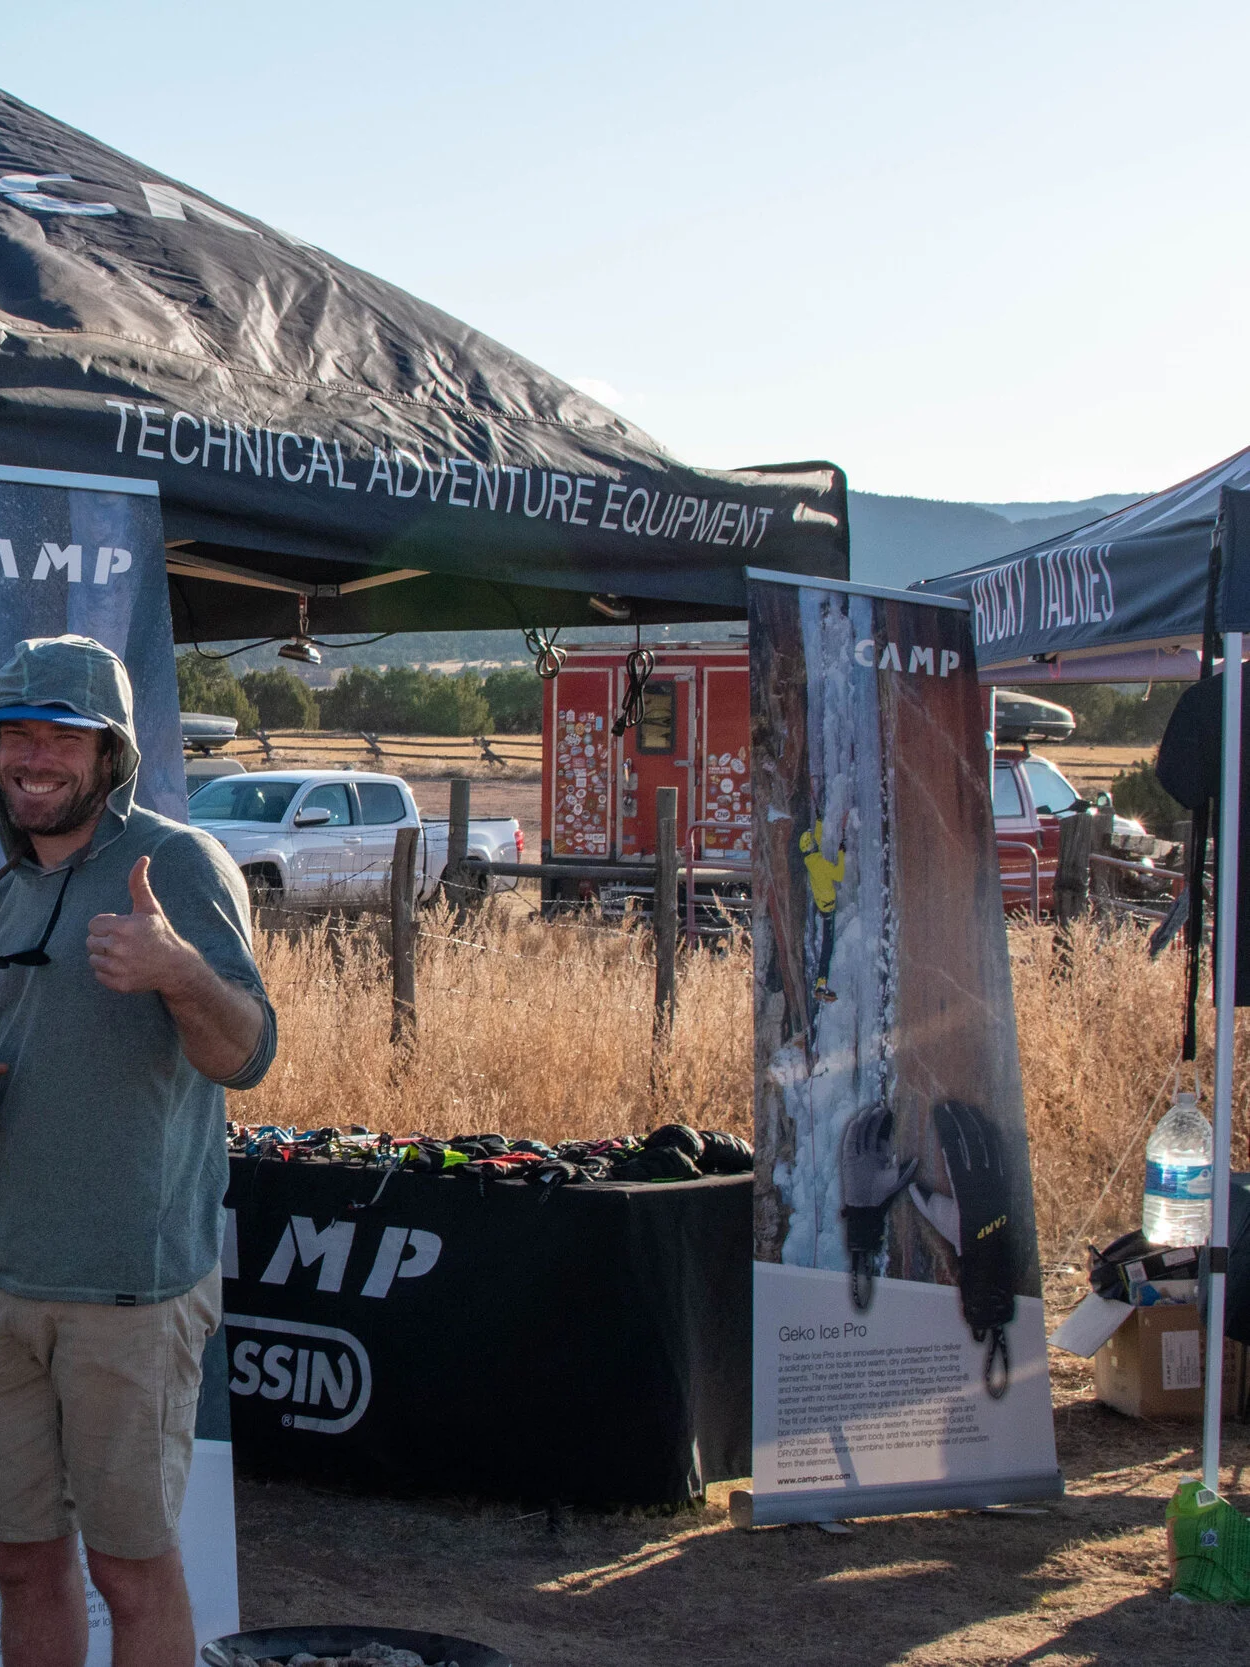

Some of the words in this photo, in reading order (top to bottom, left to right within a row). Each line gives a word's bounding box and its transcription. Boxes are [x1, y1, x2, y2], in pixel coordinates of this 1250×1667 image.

[106, 400, 357, 490] TECHNICAL
[366, 446, 593, 525] ADVENTURE
[599, 483, 774, 549] EQUIPMENT
[971, 557, 1028, 646] ROCKY
[1034, 542, 1115, 630] TALKIES
[854, 639, 961, 678] CAMP
[975, 1214, 1008, 1240] CAMP
[778, 1326, 815, 1342] Geko
[819, 1324, 840, 1339] Ice
[843, 1322, 867, 1338] Pro
[229, 1340, 354, 1410] SSIN
[776, 1474, 851, 1485] www.camp-usa.com
